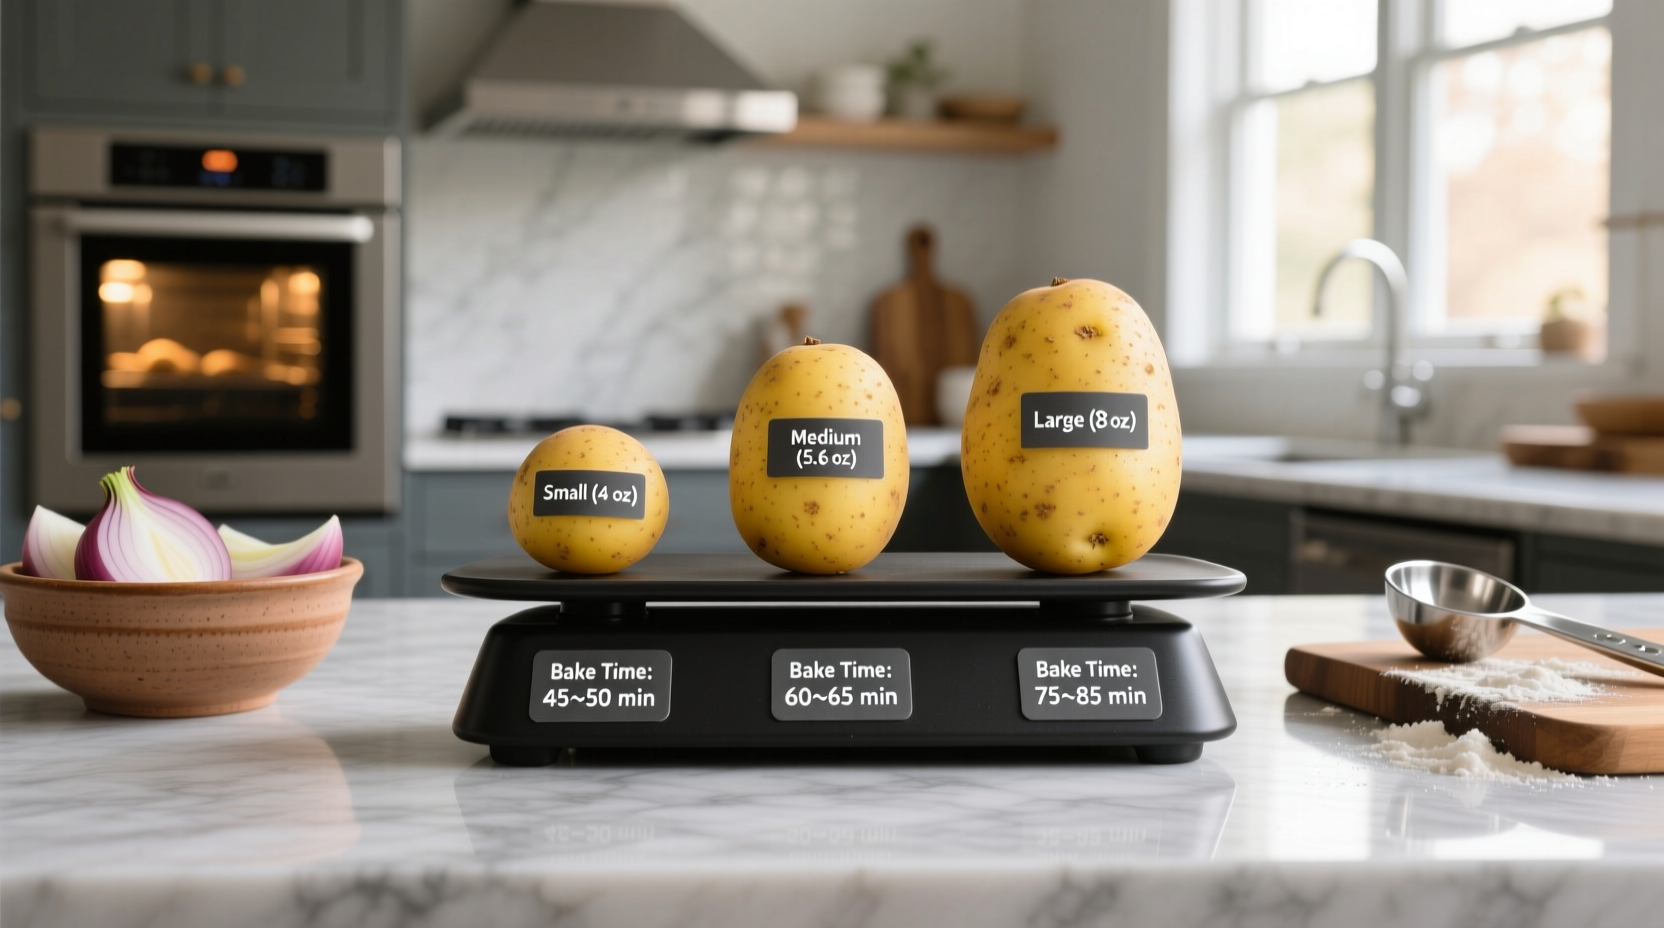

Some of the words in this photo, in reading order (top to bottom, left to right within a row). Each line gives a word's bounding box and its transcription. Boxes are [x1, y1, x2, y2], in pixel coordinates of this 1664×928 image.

[1033, 409, 1084, 434] Large
[1089, 408, 1107, 433] (8
[1109, 408, 1137, 433] oz)
[791, 427, 862, 446] Medium
[796, 448, 828, 470] (5.6
[831, 449, 857, 470] oz)
[543, 483, 588, 502] Small
[591, 484, 609, 506] (4
[612, 485, 638, 507] oz)
[550, 661, 597, 681] Bake
[600, 661, 653, 681] Time:
[789, 660, 836, 679] Bake
[839, 660, 892, 679] Time:
[1035, 659, 1082, 679] Bake
[1084, 659, 1138, 679] Time:
[542, 687, 612, 708] 45~50
[618, 687, 655, 708] min
[784, 686, 854, 707] 60~65
[860, 686, 898, 707] min
[1034, 685, 1102, 706] 75~85
[1107, 685, 1147, 706] min
